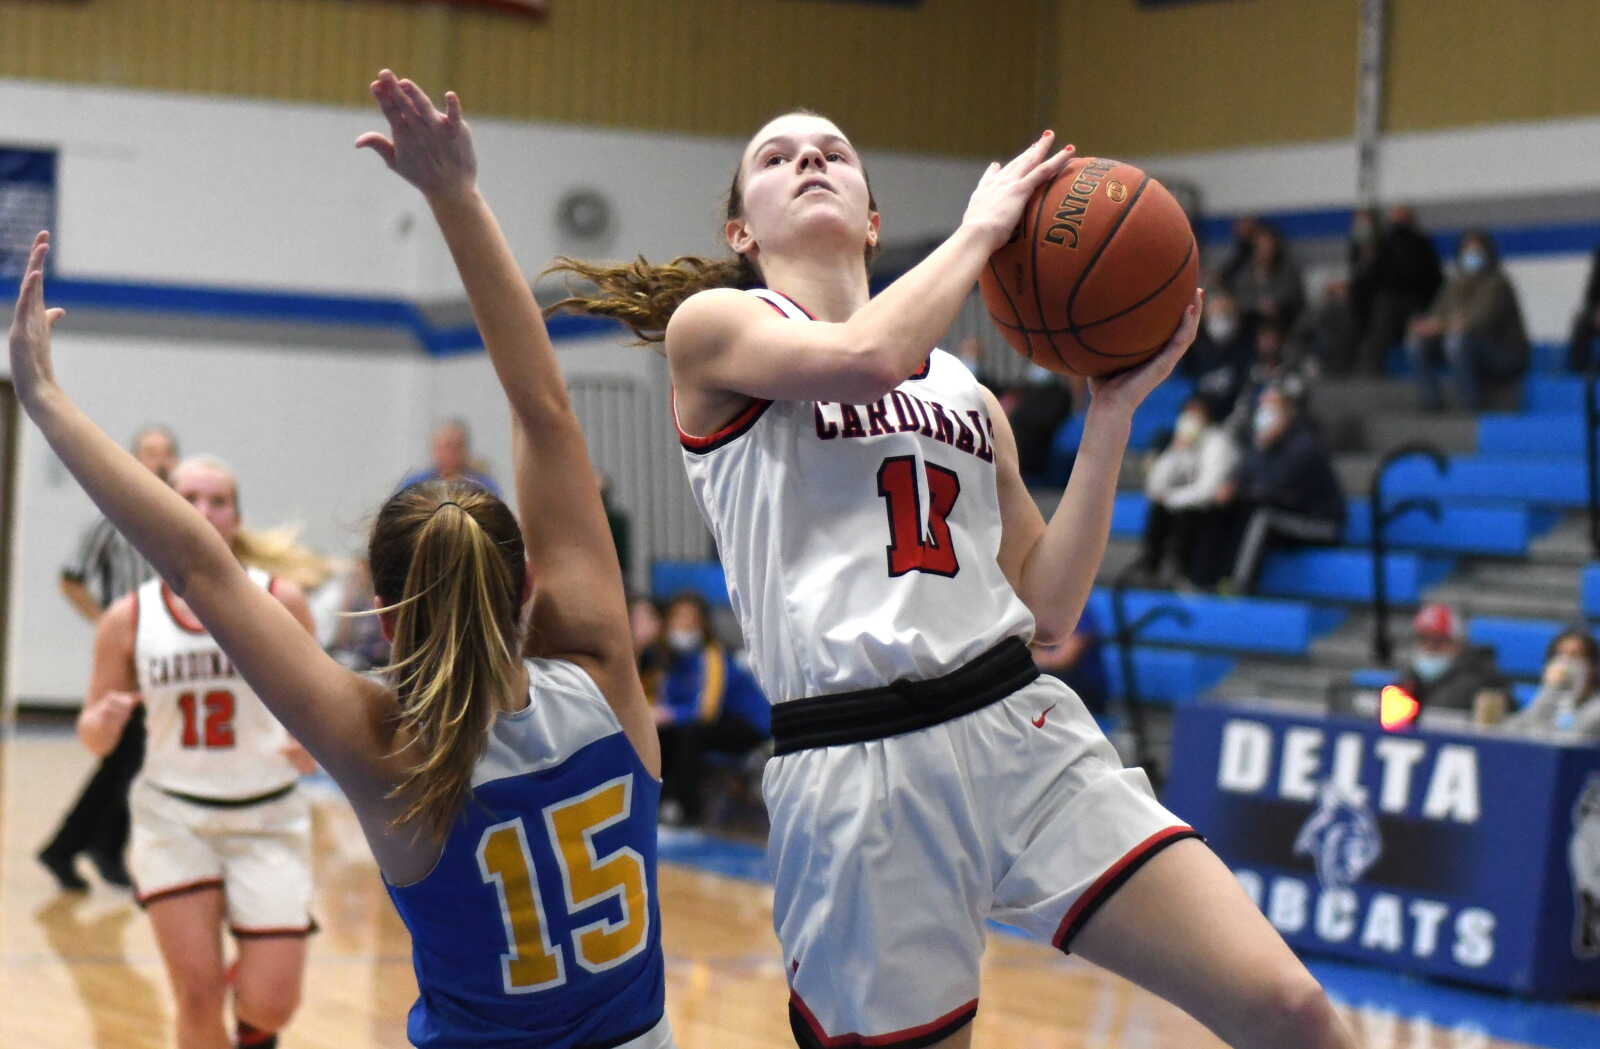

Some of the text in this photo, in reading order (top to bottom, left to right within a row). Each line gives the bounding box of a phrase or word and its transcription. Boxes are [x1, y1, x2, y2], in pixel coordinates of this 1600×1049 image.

[177, 690, 236, 749] 12
[1217, 718, 1482, 823] DELTA
[475, 773, 650, 995] 15
[1233, 868, 1496, 967] BCATS
